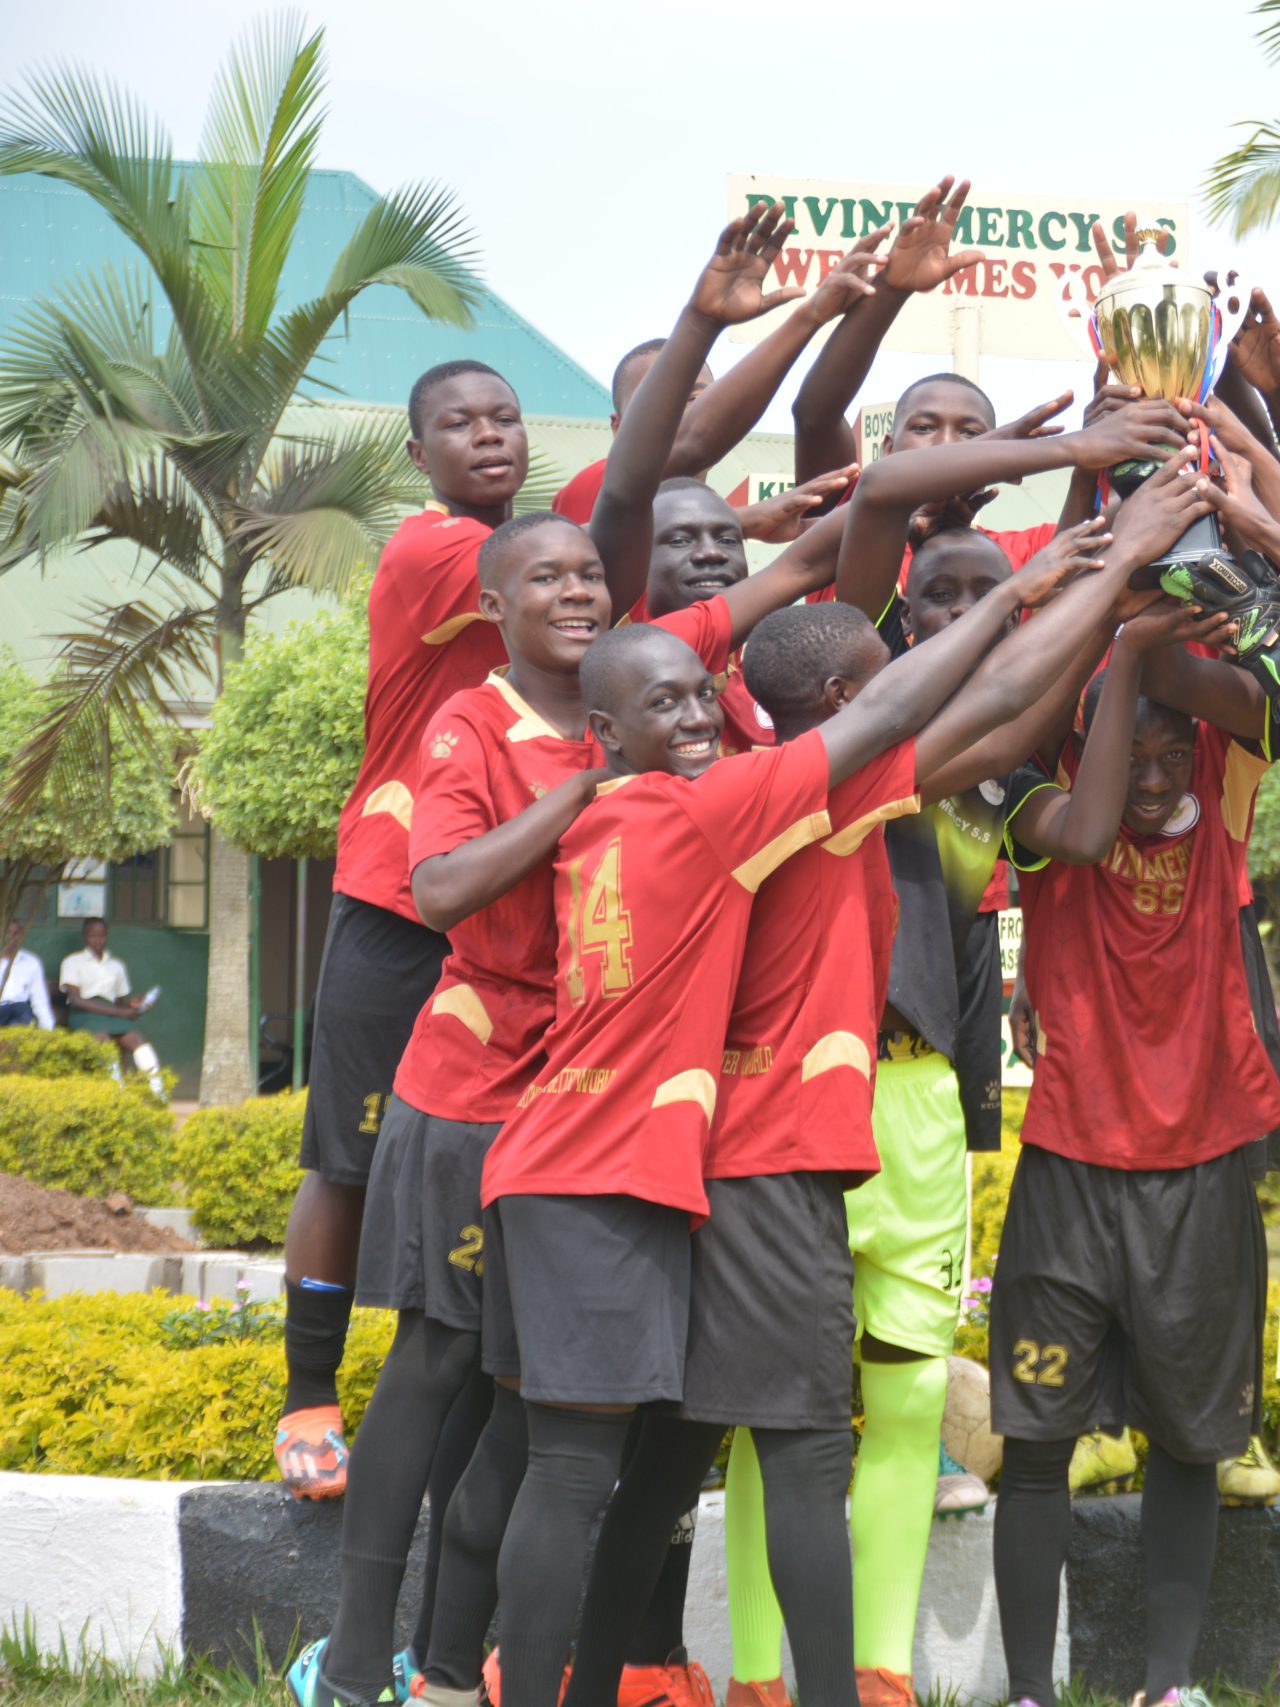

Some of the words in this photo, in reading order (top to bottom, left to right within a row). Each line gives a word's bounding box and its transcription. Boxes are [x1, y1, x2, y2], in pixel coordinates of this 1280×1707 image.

[773, 248, 1037, 300] WEMES
[1048, 263, 1126, 303] YO
[864, 411, 893, 438] BOYS
[566, 836, 634, 1008] 14
[1132, 882, 1185, 915] SS
[448, 1223, 485, 1278] 2
[1012, 1338, 1069, 1387] 22
